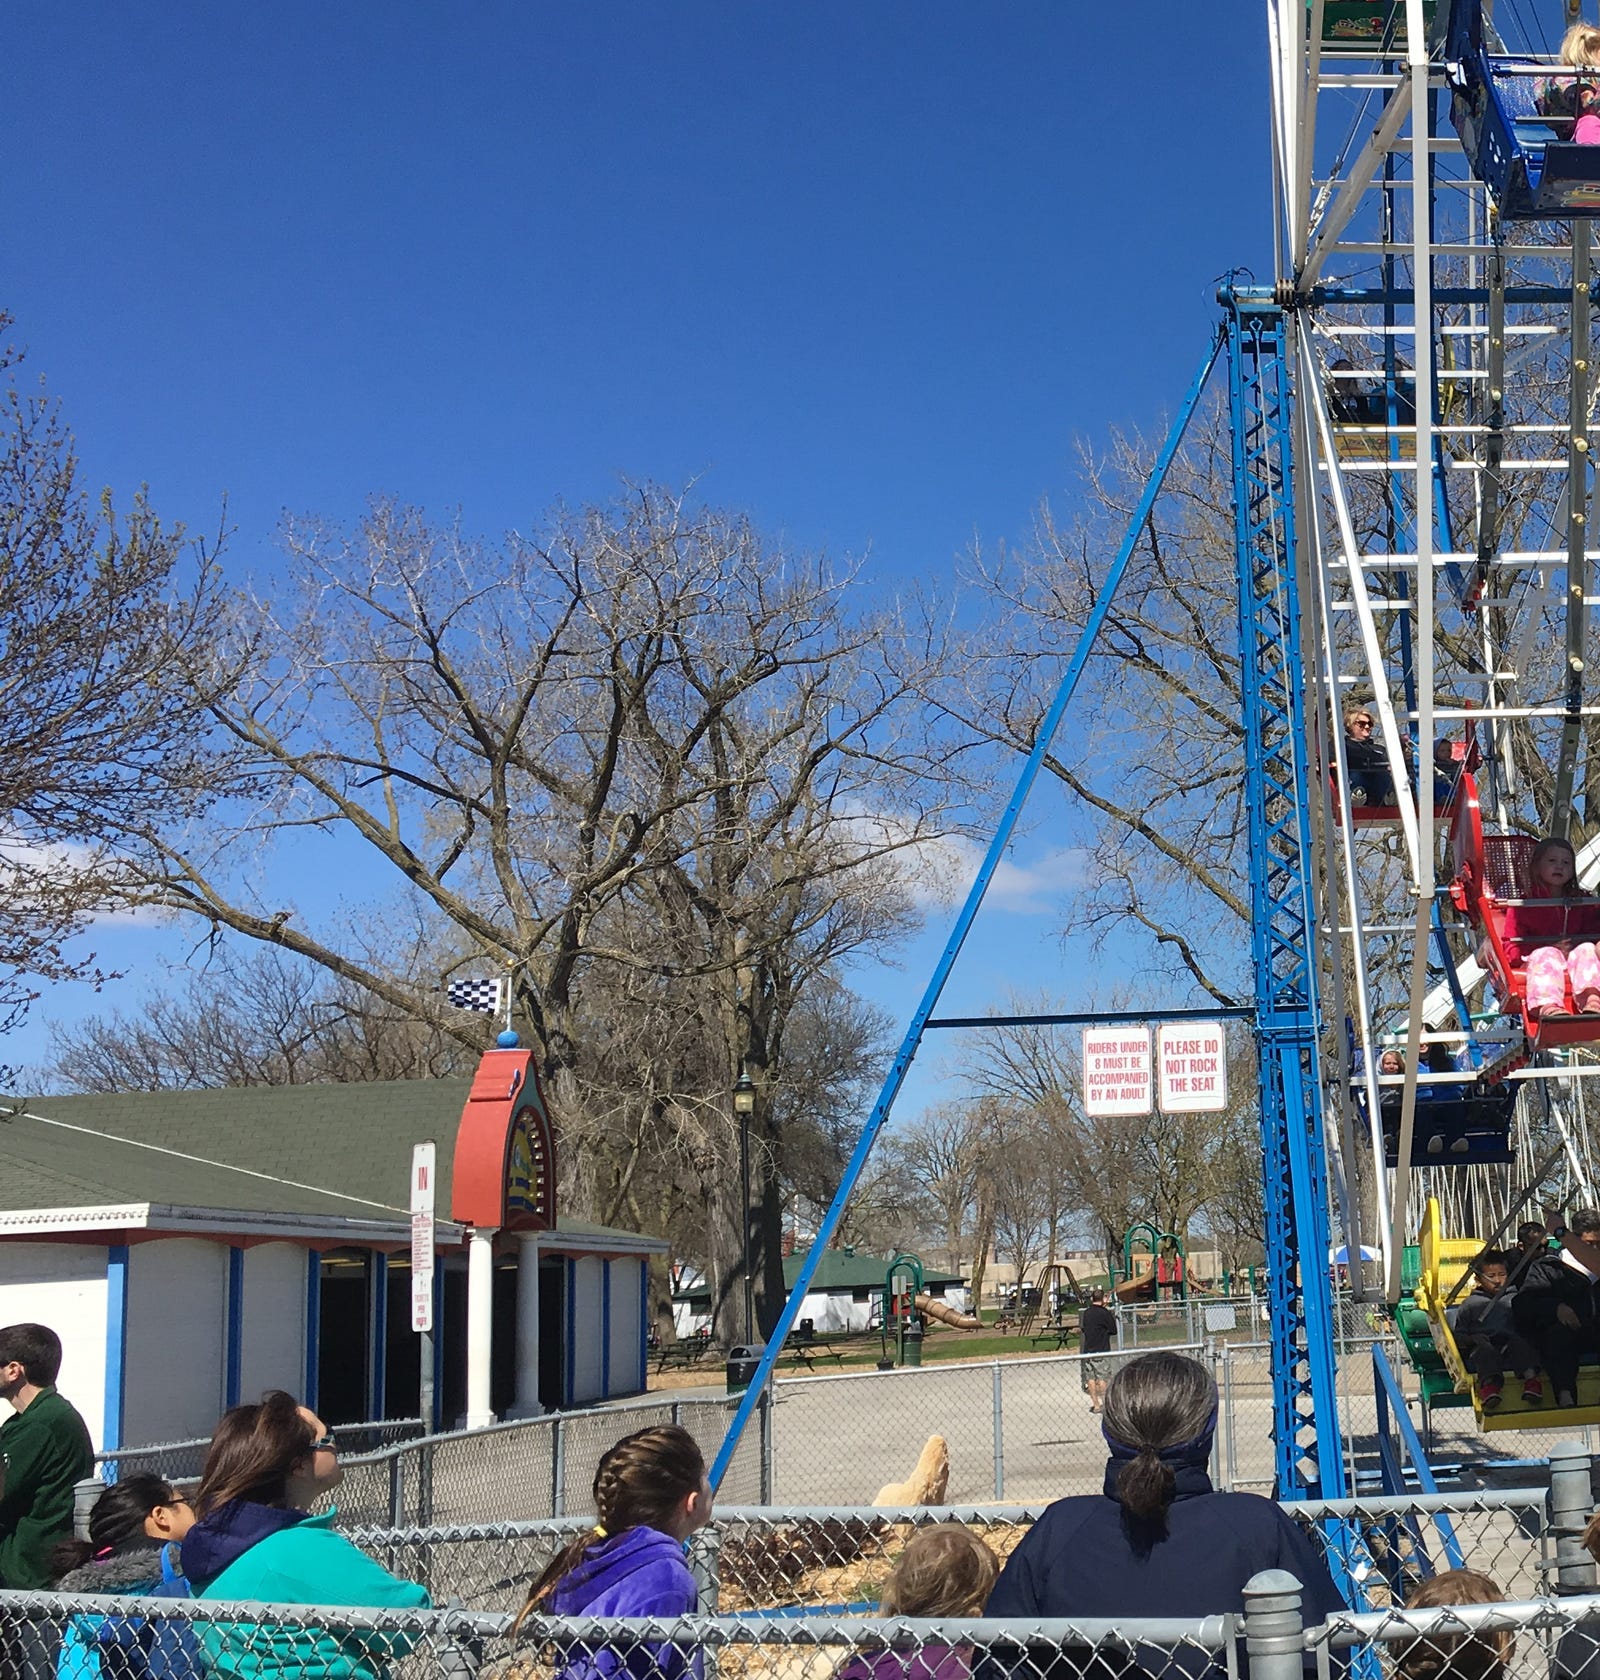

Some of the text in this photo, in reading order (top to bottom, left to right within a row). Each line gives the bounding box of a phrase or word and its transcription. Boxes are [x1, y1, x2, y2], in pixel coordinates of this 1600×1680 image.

[1088, 1041, 1148, 1054] RIDERS UNDER
[1164, 1039, 1218, 1055] PLEASE DO
[1095, 1057, 1141, 1069] 8 MUST BE
[1165, 1058, 1217, 1073] NOT ROCK
[1088, 1072, 1148, 1085] ACCOMPANIED
[1169, 1077, 1216, 1092] THE SEAT
[1091, 1087, 1146, 1101] BY AN ADULT
[418, 1166, 428, 1190] IN
